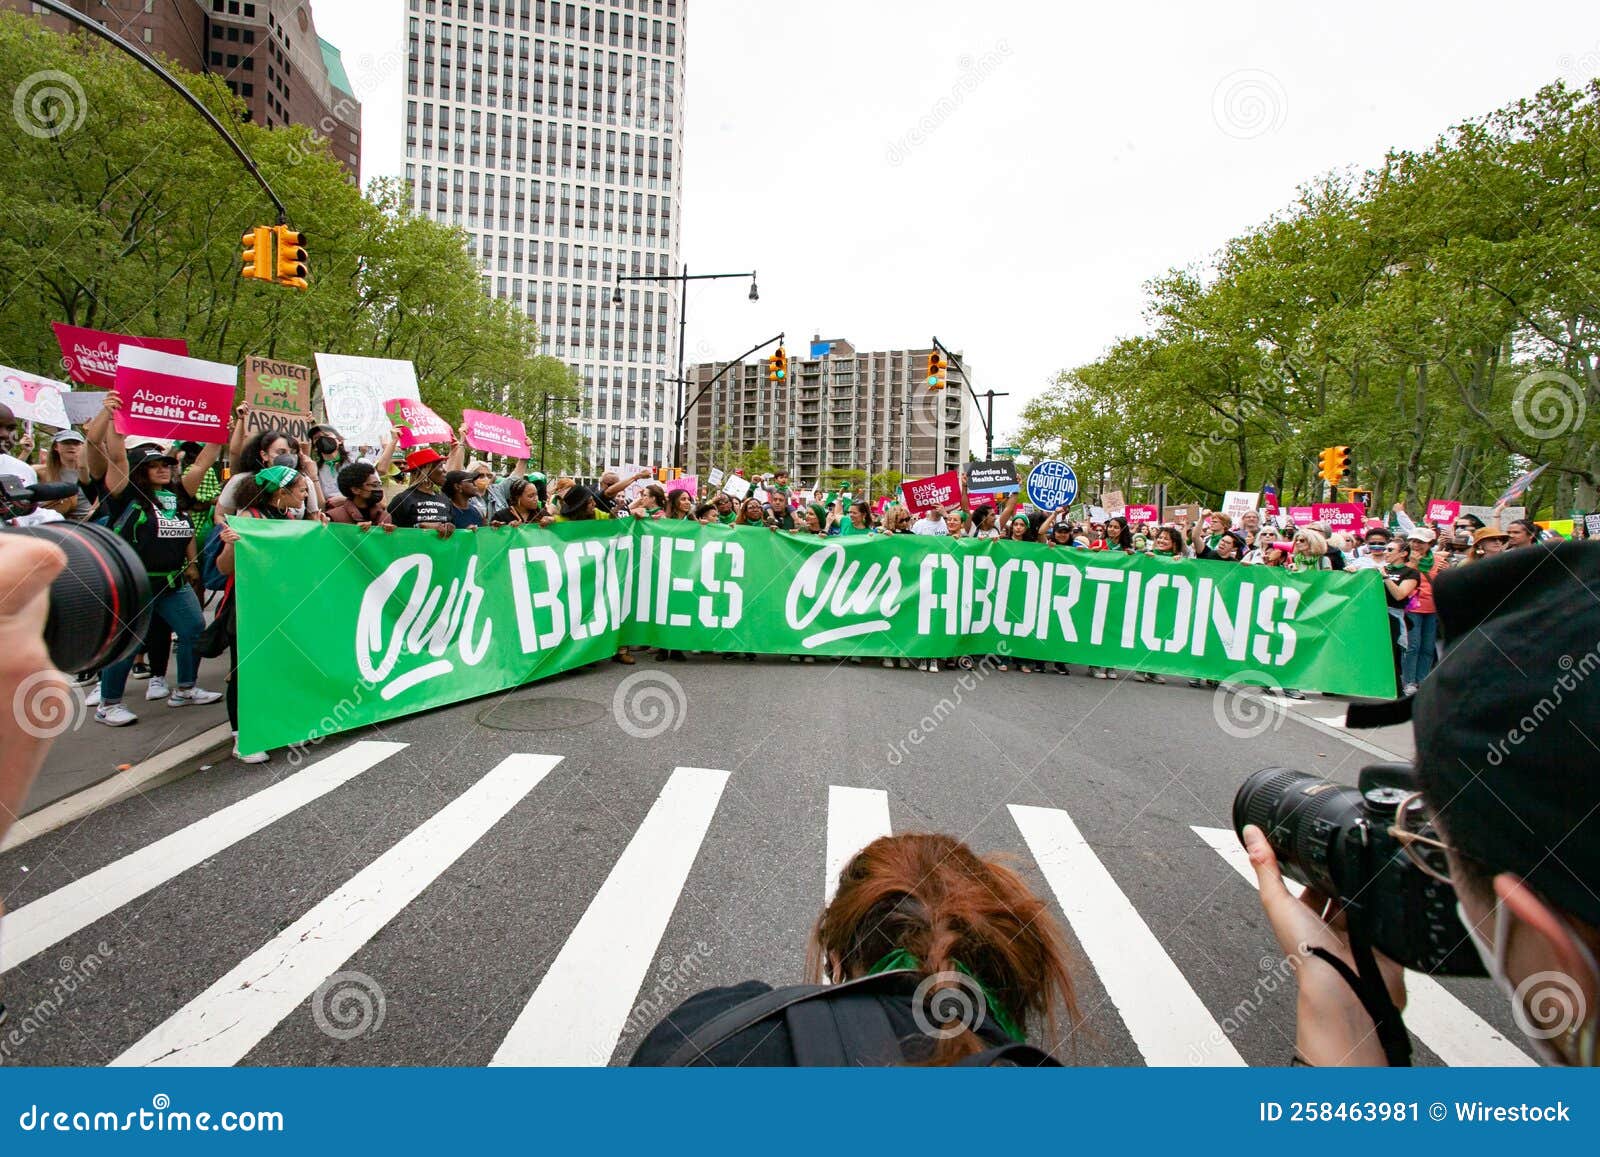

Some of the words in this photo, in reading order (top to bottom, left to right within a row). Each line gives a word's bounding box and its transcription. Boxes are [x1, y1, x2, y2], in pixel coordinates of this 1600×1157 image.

[74, 344, 119, 361] Abortio
[76, 355, 118, 373] Healt
[252, 360, 307, 381] PROTECT
[257, 374, 299, 396] SAFE
[132, 388, 195, 408] Abortion
[198, 398, 208, 410] is
[254, 392, 302, 412] LEGAL
[131, 401, 185, 419] Health
[188, 410, 221, 423] Care.
[1001, 467, 1008, 475] is
[1040, 462, 1071, 478] KEEP
[971, 475, 994, 483] Health
[1030, 473, 1075, 493] ABORTION
[912, 482, 937, 495] BANS
[914, 491, 931, 500] OFF
[931, 485, 952, 497] OUR
[1032, 487, 1069, 506] LEGAL
[916, 493, 950, 507] BODIES
[1335, 512, 1354, 520] OUR
[160, 529, 194, 537] WOMEN
[355, 553, 493, 683] Our
[508, 534, 745, 655] BODIES
[785, 543, 903, 631] Our
[917, 553, 1301, 667] ABORTIONS
